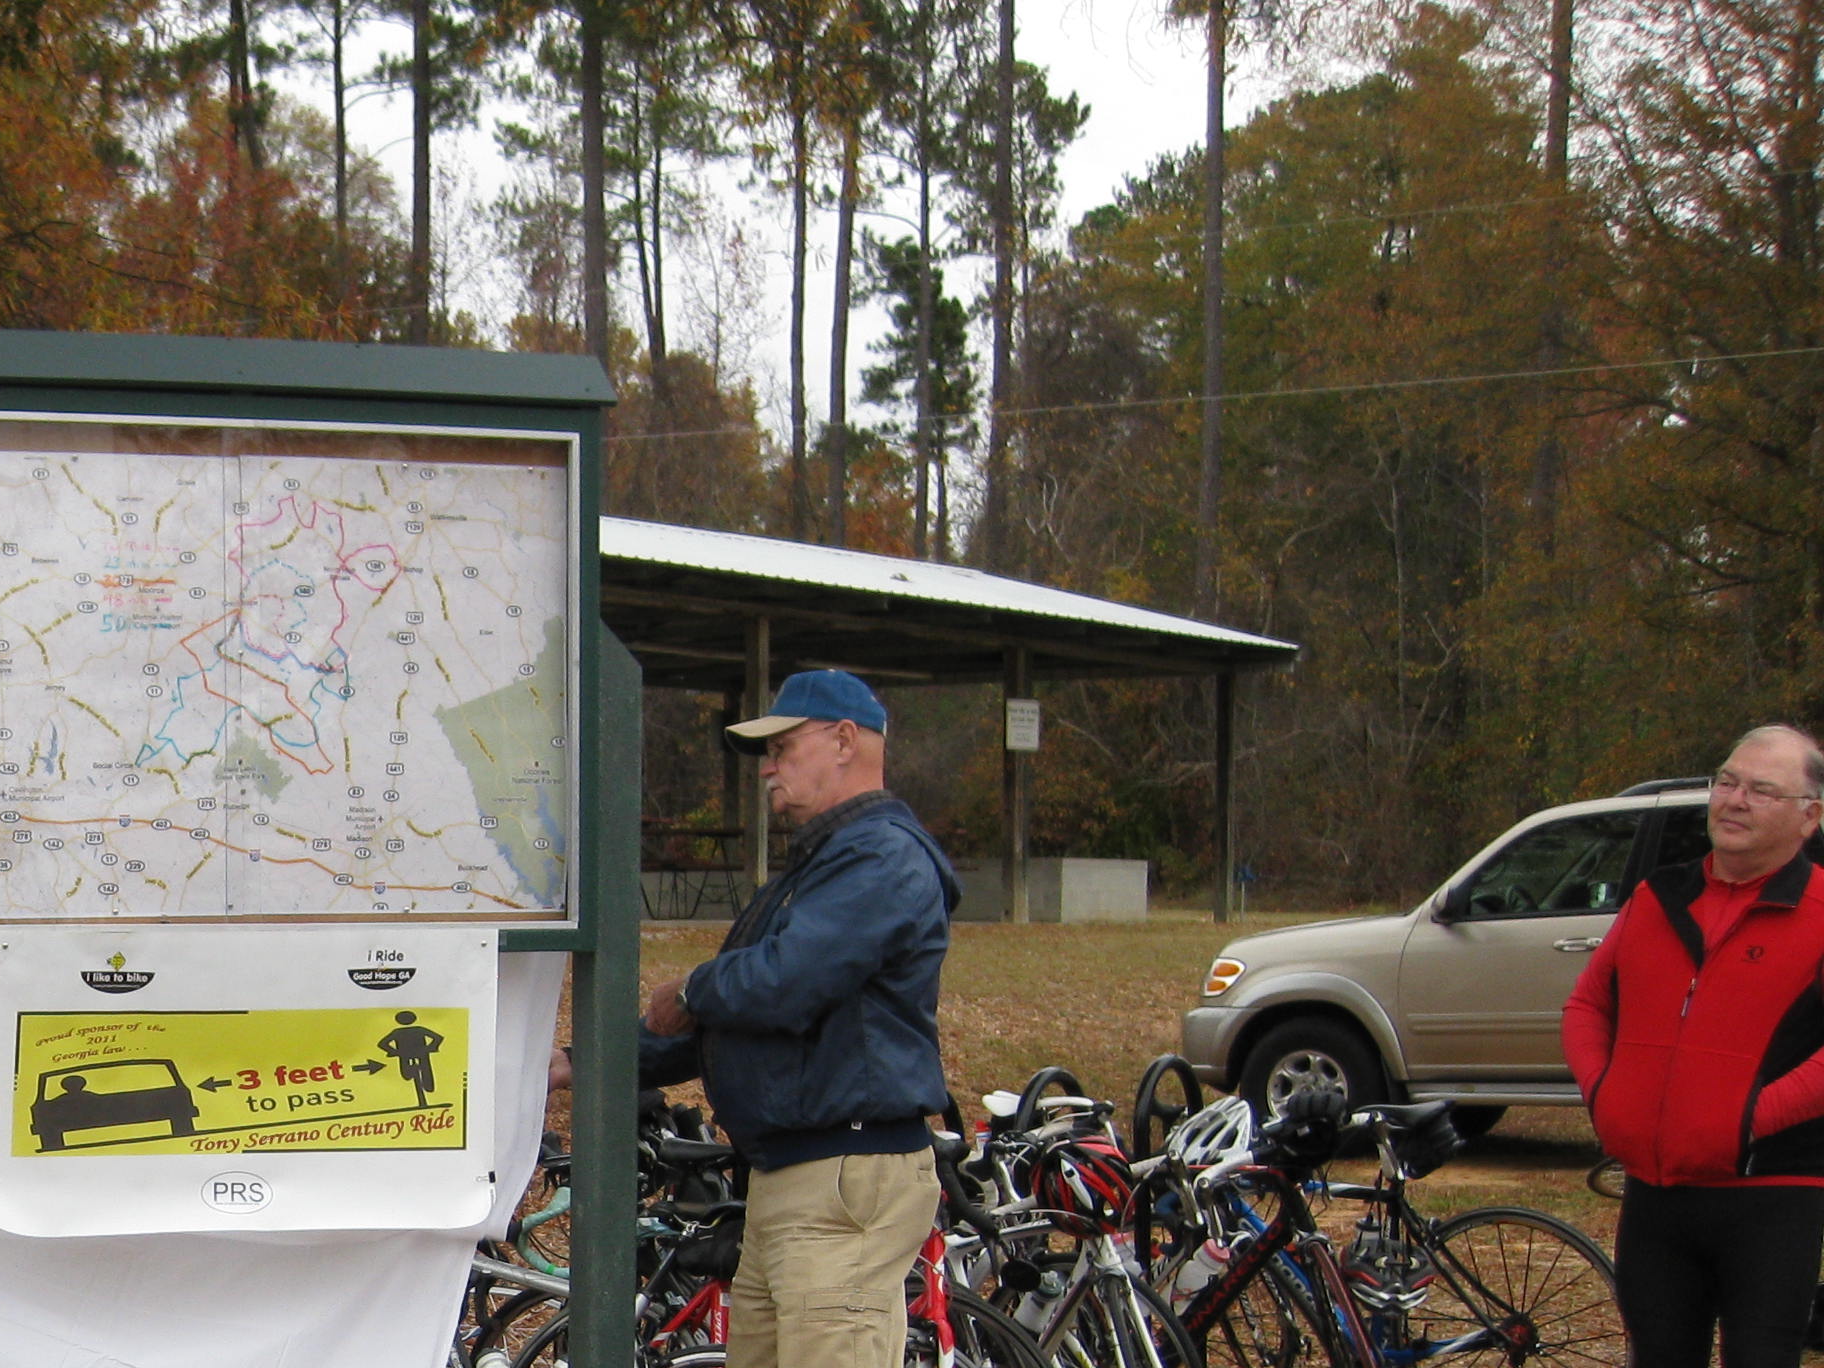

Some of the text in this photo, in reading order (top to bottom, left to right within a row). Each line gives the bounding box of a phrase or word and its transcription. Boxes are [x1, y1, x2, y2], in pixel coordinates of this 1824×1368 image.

[375, 949, 404, 962] Ride
[86, 972, 149, 983] I like to bike
[353, 971, 410, 981] Good Hope GA
[76, 1024, 124, 1037] sponsor
[126, 1021, 143, 1033] of
[147, 1024, 166, 1032] the
[86, 1034, 117, 1045] 2011
[51, 1047, 98, 1063] Georgia
[236, 1060, 345, 1090] 3 feet
[246, 1088, 355, 1113] to pass
[190, 1109, 456, 1153] Tony Serrano Century Ride
[214, 1182, 265, 1203] PRS
